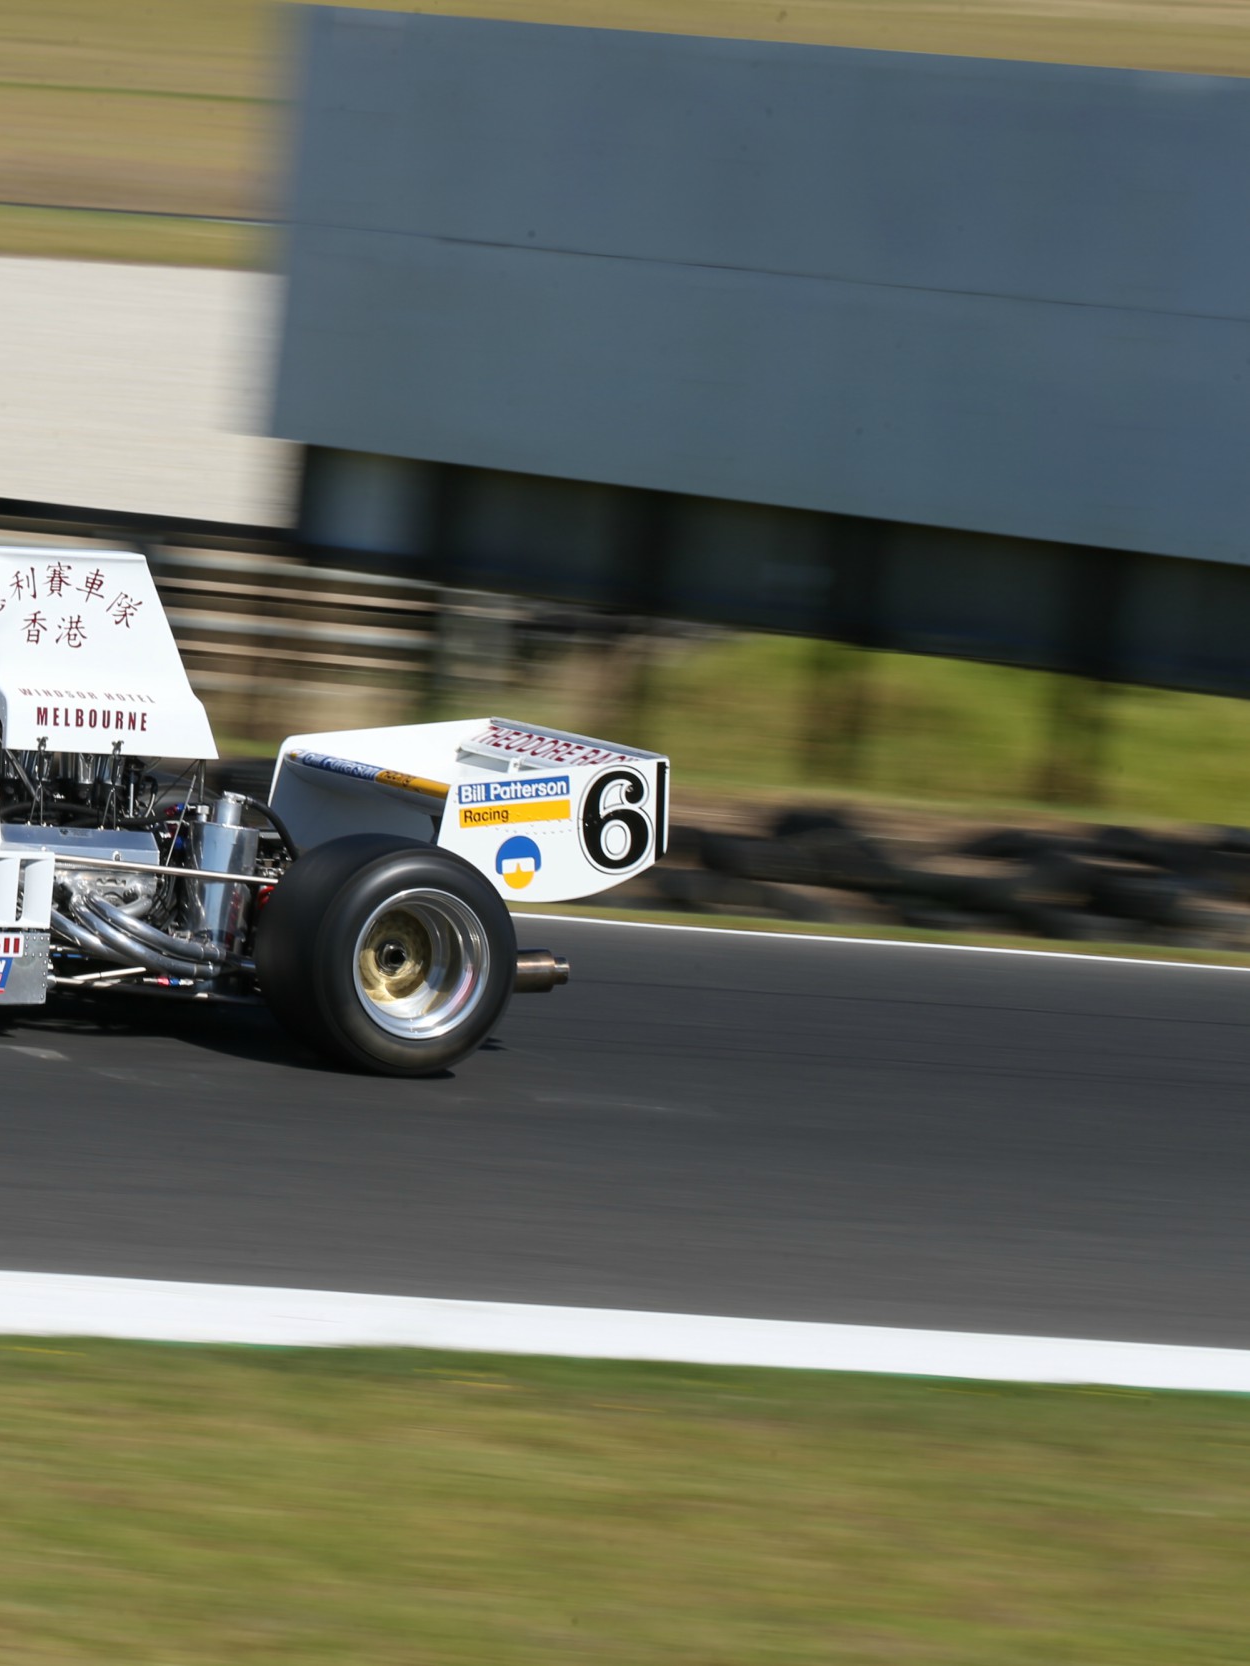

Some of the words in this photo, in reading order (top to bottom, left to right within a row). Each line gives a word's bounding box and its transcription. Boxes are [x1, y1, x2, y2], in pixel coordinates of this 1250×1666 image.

[20, 610, 88, 649] 香港
[17, 687, 97, 700] WINDSOR
[104, 692, 156, 704] HOTEL
[36, 706, 148, 732] MELBOURNE
[471, 725, 585, 762] THEODORE
[461, 785, 485, 802] Bill
[490, 780, 568, 799] Patterson
[463, 808, 510, 825] Racing
[578, 765, 653, 874] 6
